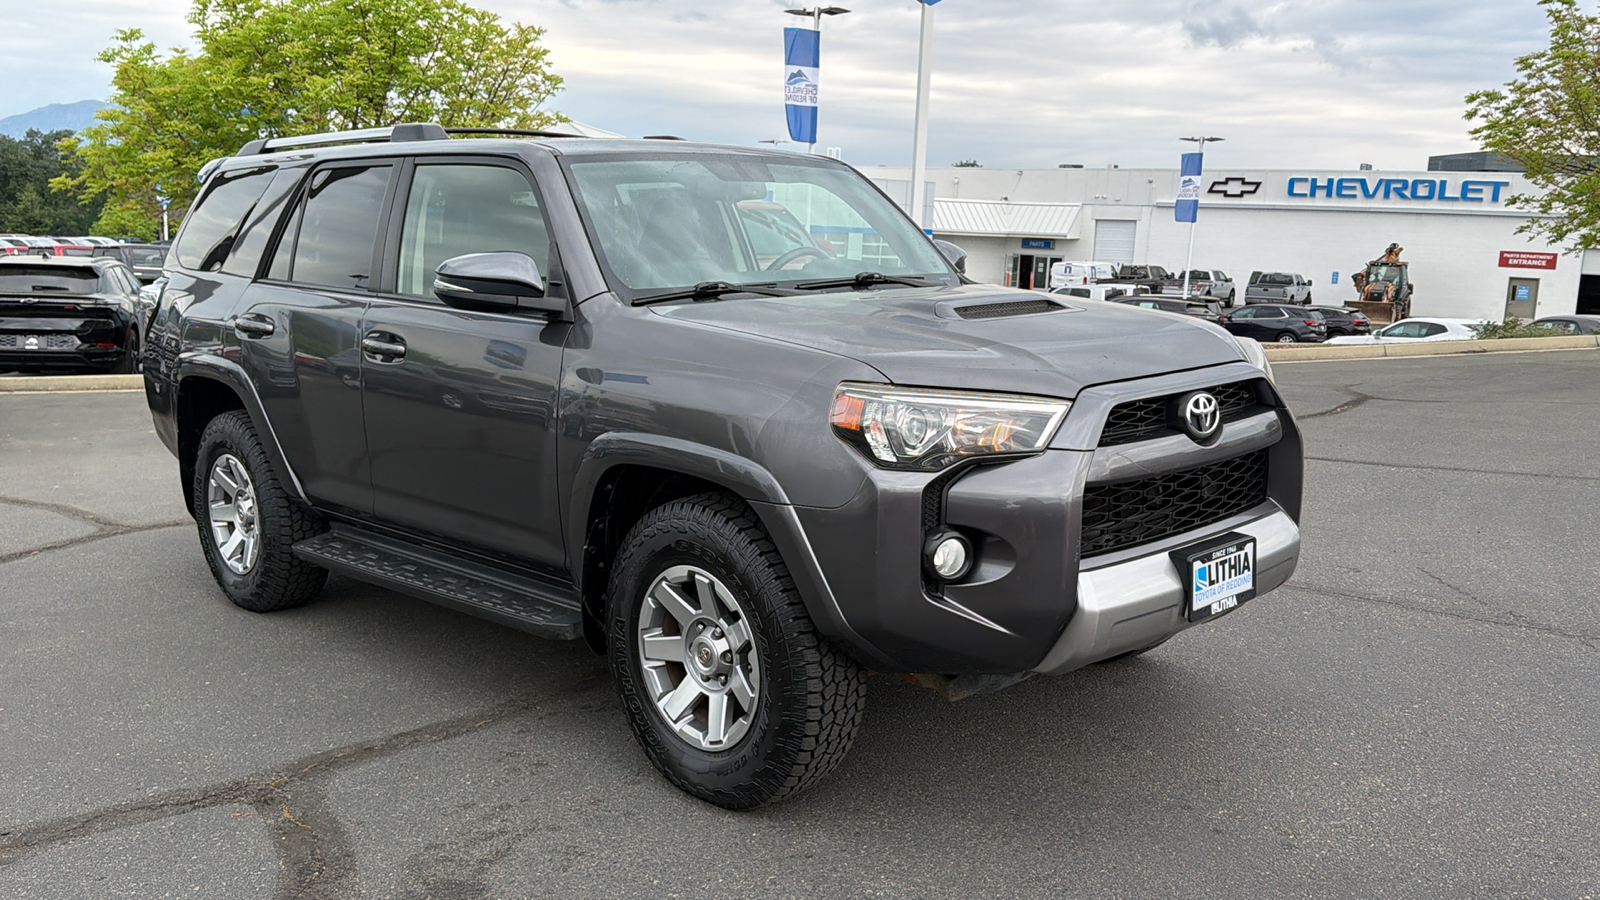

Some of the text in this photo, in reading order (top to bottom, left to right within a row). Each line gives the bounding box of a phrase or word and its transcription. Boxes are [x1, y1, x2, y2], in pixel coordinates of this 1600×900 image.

[1287, 177, 1510, 203] CHEVROLET
[1212, 548, 1226, 560] SINCE
[1208, 552, 1251, 587] LITHIA
[1195, 573, 1252, 603] TOYOTA OF REDDING
